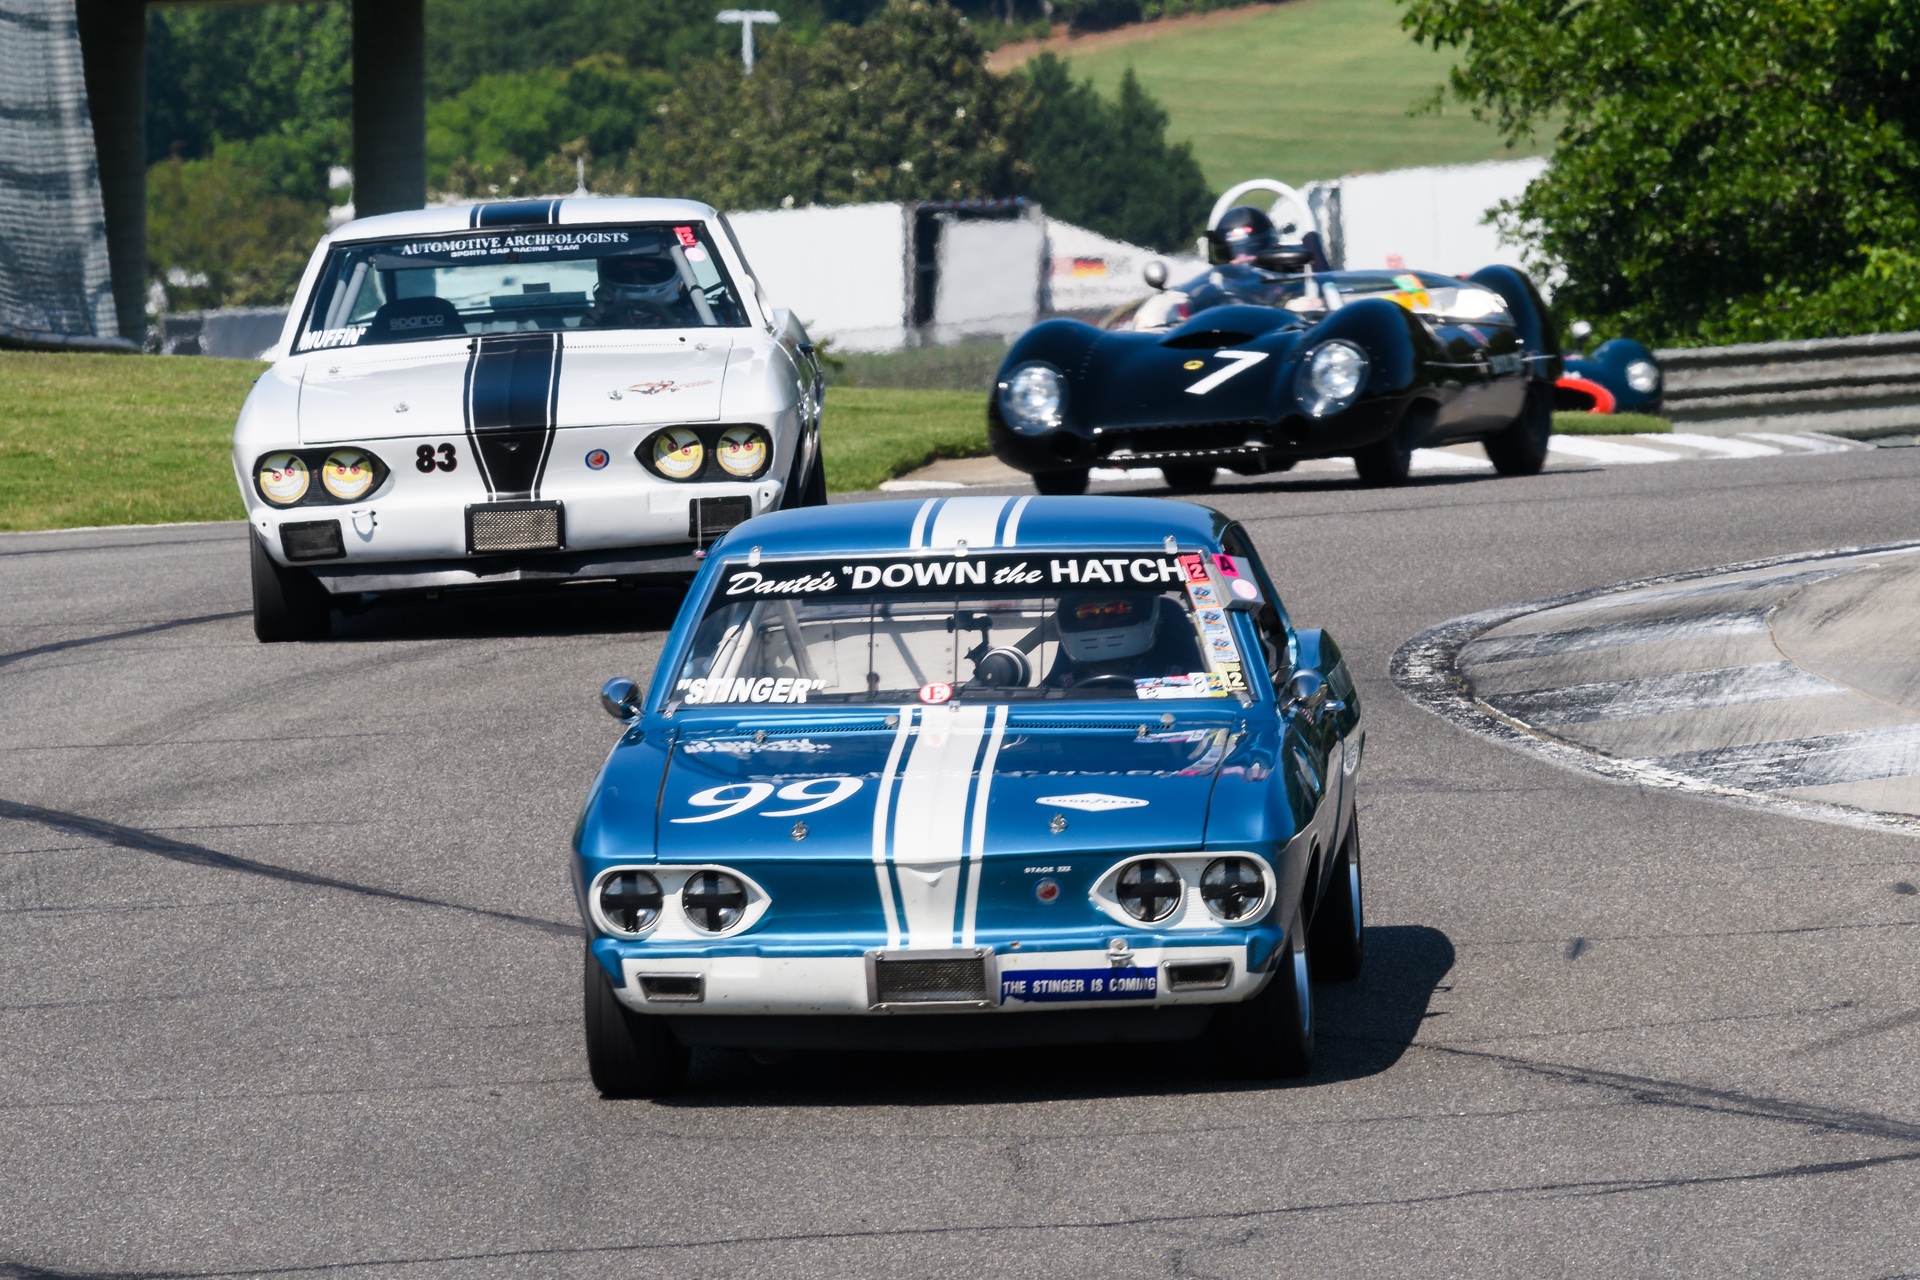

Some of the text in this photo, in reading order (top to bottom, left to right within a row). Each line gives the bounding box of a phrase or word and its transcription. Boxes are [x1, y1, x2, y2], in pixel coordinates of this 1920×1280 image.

[400, 232, 630, 256] AUTOMOTIVE ARCHEOLOGISTS
[450, 249, 488, 258] SPORTS
[489, 247, 511, 255] CAR
[512, 245, 550, 253] RACING
[389, 314, 444, 328] sparco
[1184, 350, 1270, 395] 7
[415, 442, 458, 474] 83
[1219, 556, 1236, 573] A
[725, 571, 838, 596] Dante's
[991, 562, 1043, 585] the
[1050, 558, 1187, 583] HATCH
[668, 776, 864, 824] 99
[1023, 866, 1054, 874] STAGE
[1002, 977, 1157, 995] THE STINGER IS COMING
